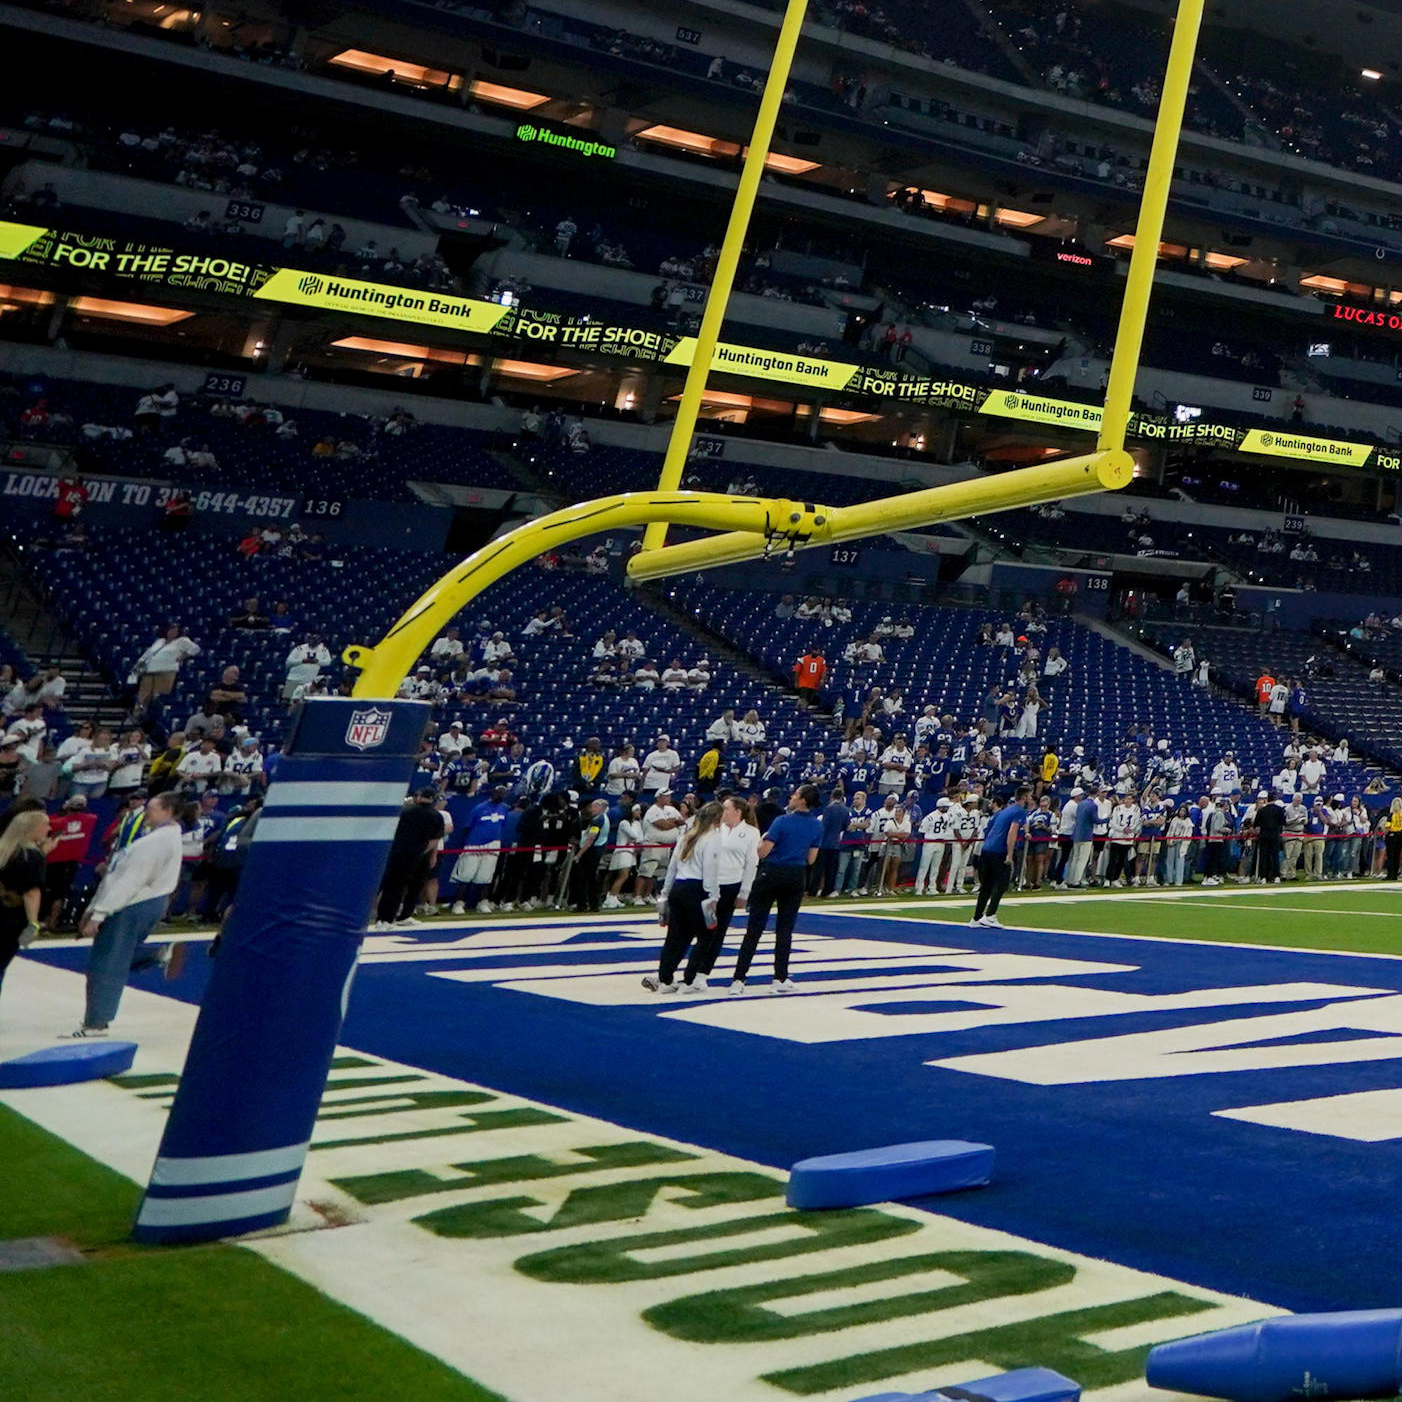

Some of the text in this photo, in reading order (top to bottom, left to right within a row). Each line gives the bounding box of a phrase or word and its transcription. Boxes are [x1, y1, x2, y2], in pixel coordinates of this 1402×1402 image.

[679, 29, 699, 42] 537
[537, 128, 616, 159] Huntington
[228, 203, 261, 219] 336
[53, 243, 251, 282] FOR THE SHOE!
[1057, 252, 1092, 265] verizon
[326, 282, 425, 310] Huntington
[428, 299, 472, 317] Bank
[1333, 304, 1386, 326] LUCAS
[515, 318, 661, 350] FOR THE SHOE!
[973, 344, 991, 354] 338
[718, 348, 829, 377] Huntington Bank
[208, 376, 242, 392] 236
[863, 376, 976, 401] FOR THE SHOE!
[1253, 390, 1271, 400] 339
[1020, 398, 1102, 423] Huntington Ban
[1138, 421, 1236, 442] FOR THE SHOE!
[1275, 437, 1352, 456] Huntington Bank
[1377, 454, 1399, 469] FOR
[123, 484, 150, 505] TO
[304, 499, 341, 516] 136
[1285, 519, 1304, 530] 239
[832, 550, 858, 564] 137
[1087, 578, 1108, 590] 138
[351, 725, 381, 745] NFL
